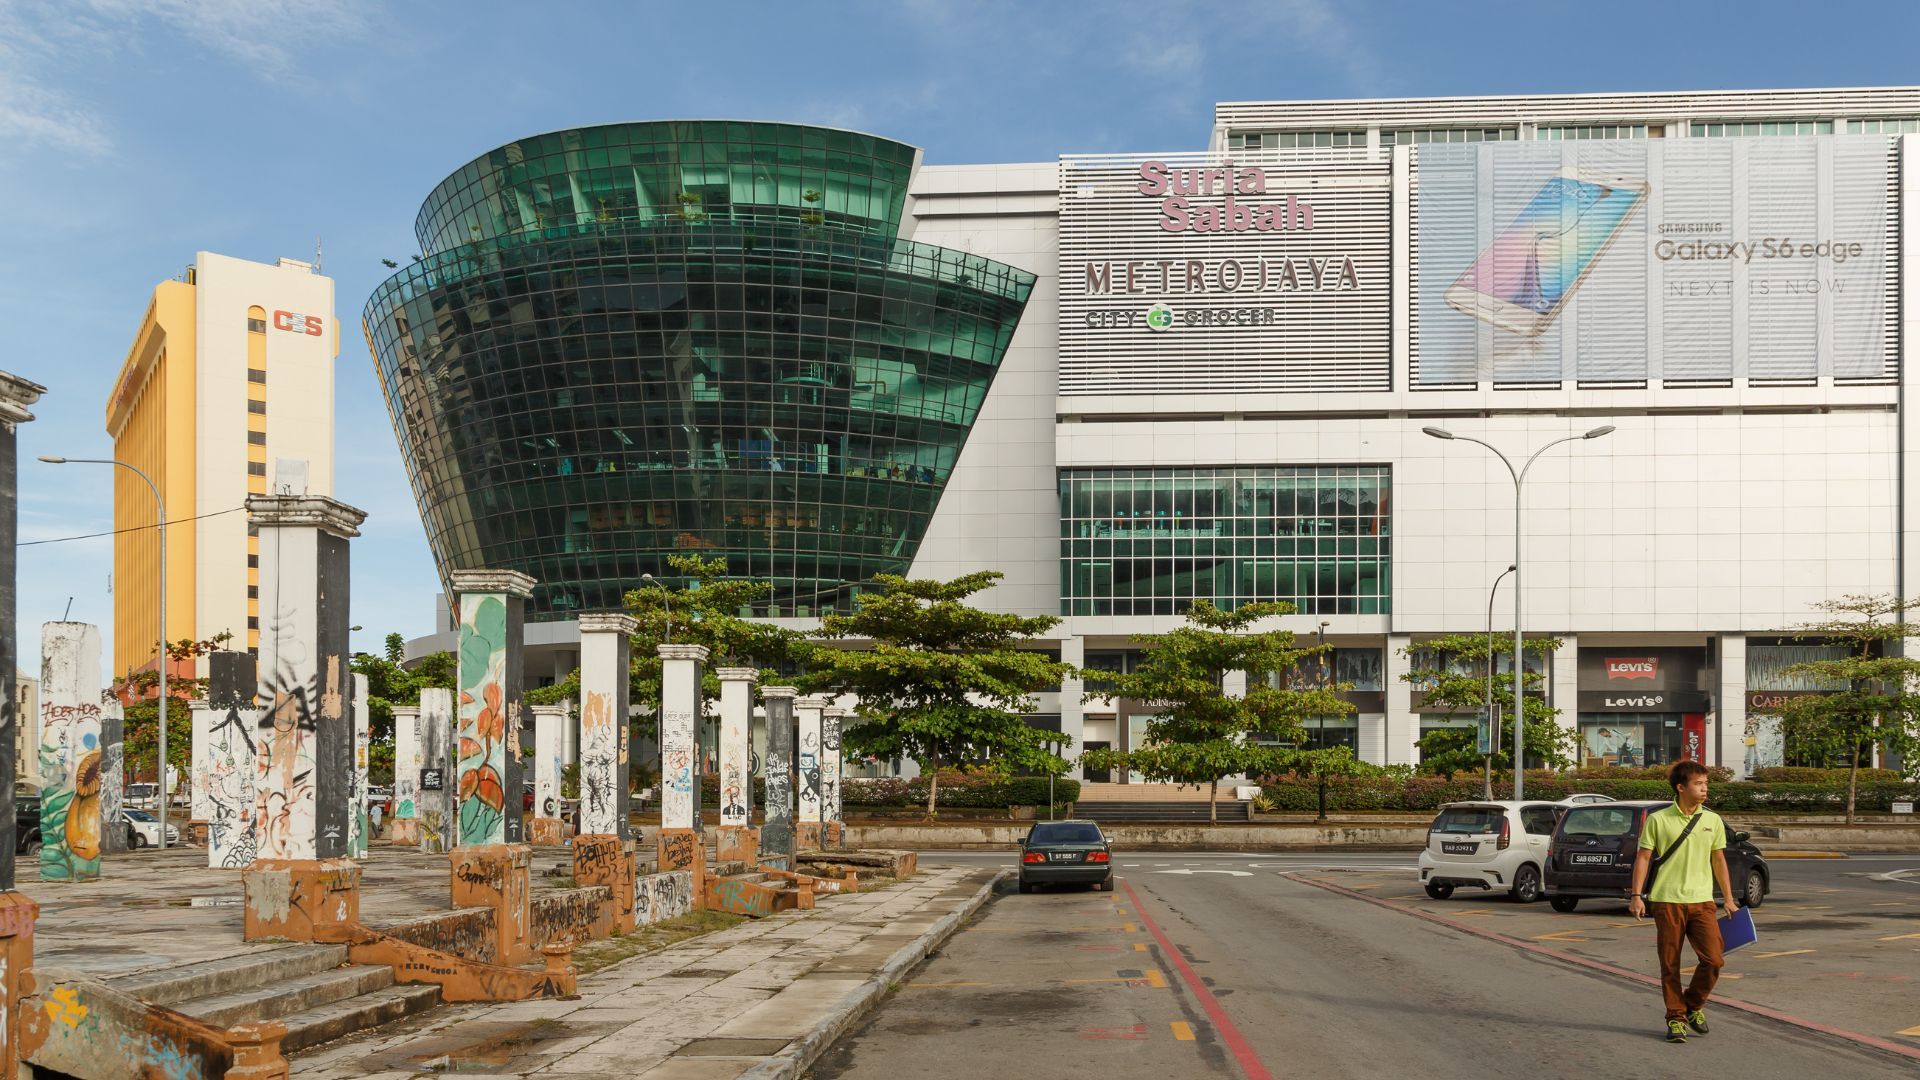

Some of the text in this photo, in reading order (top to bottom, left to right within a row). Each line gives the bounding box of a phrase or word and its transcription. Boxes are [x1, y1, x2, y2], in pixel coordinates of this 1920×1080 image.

[1138, 159, 1266, 196] Suria
[1159, 196, 1315, 233] Sabah
[1657, 223, 1723, 234] SAMSUNG
[1654, 237, 1864, 265] Galaxy S6 edge
[1085, 255, 1360, 295] METROJAYA
[1669, 278, 1847, 297] NEXT IS NOW
[1085, 310, 1138, 328] CITY
[1183, 308, 1276, 326] GROCER
